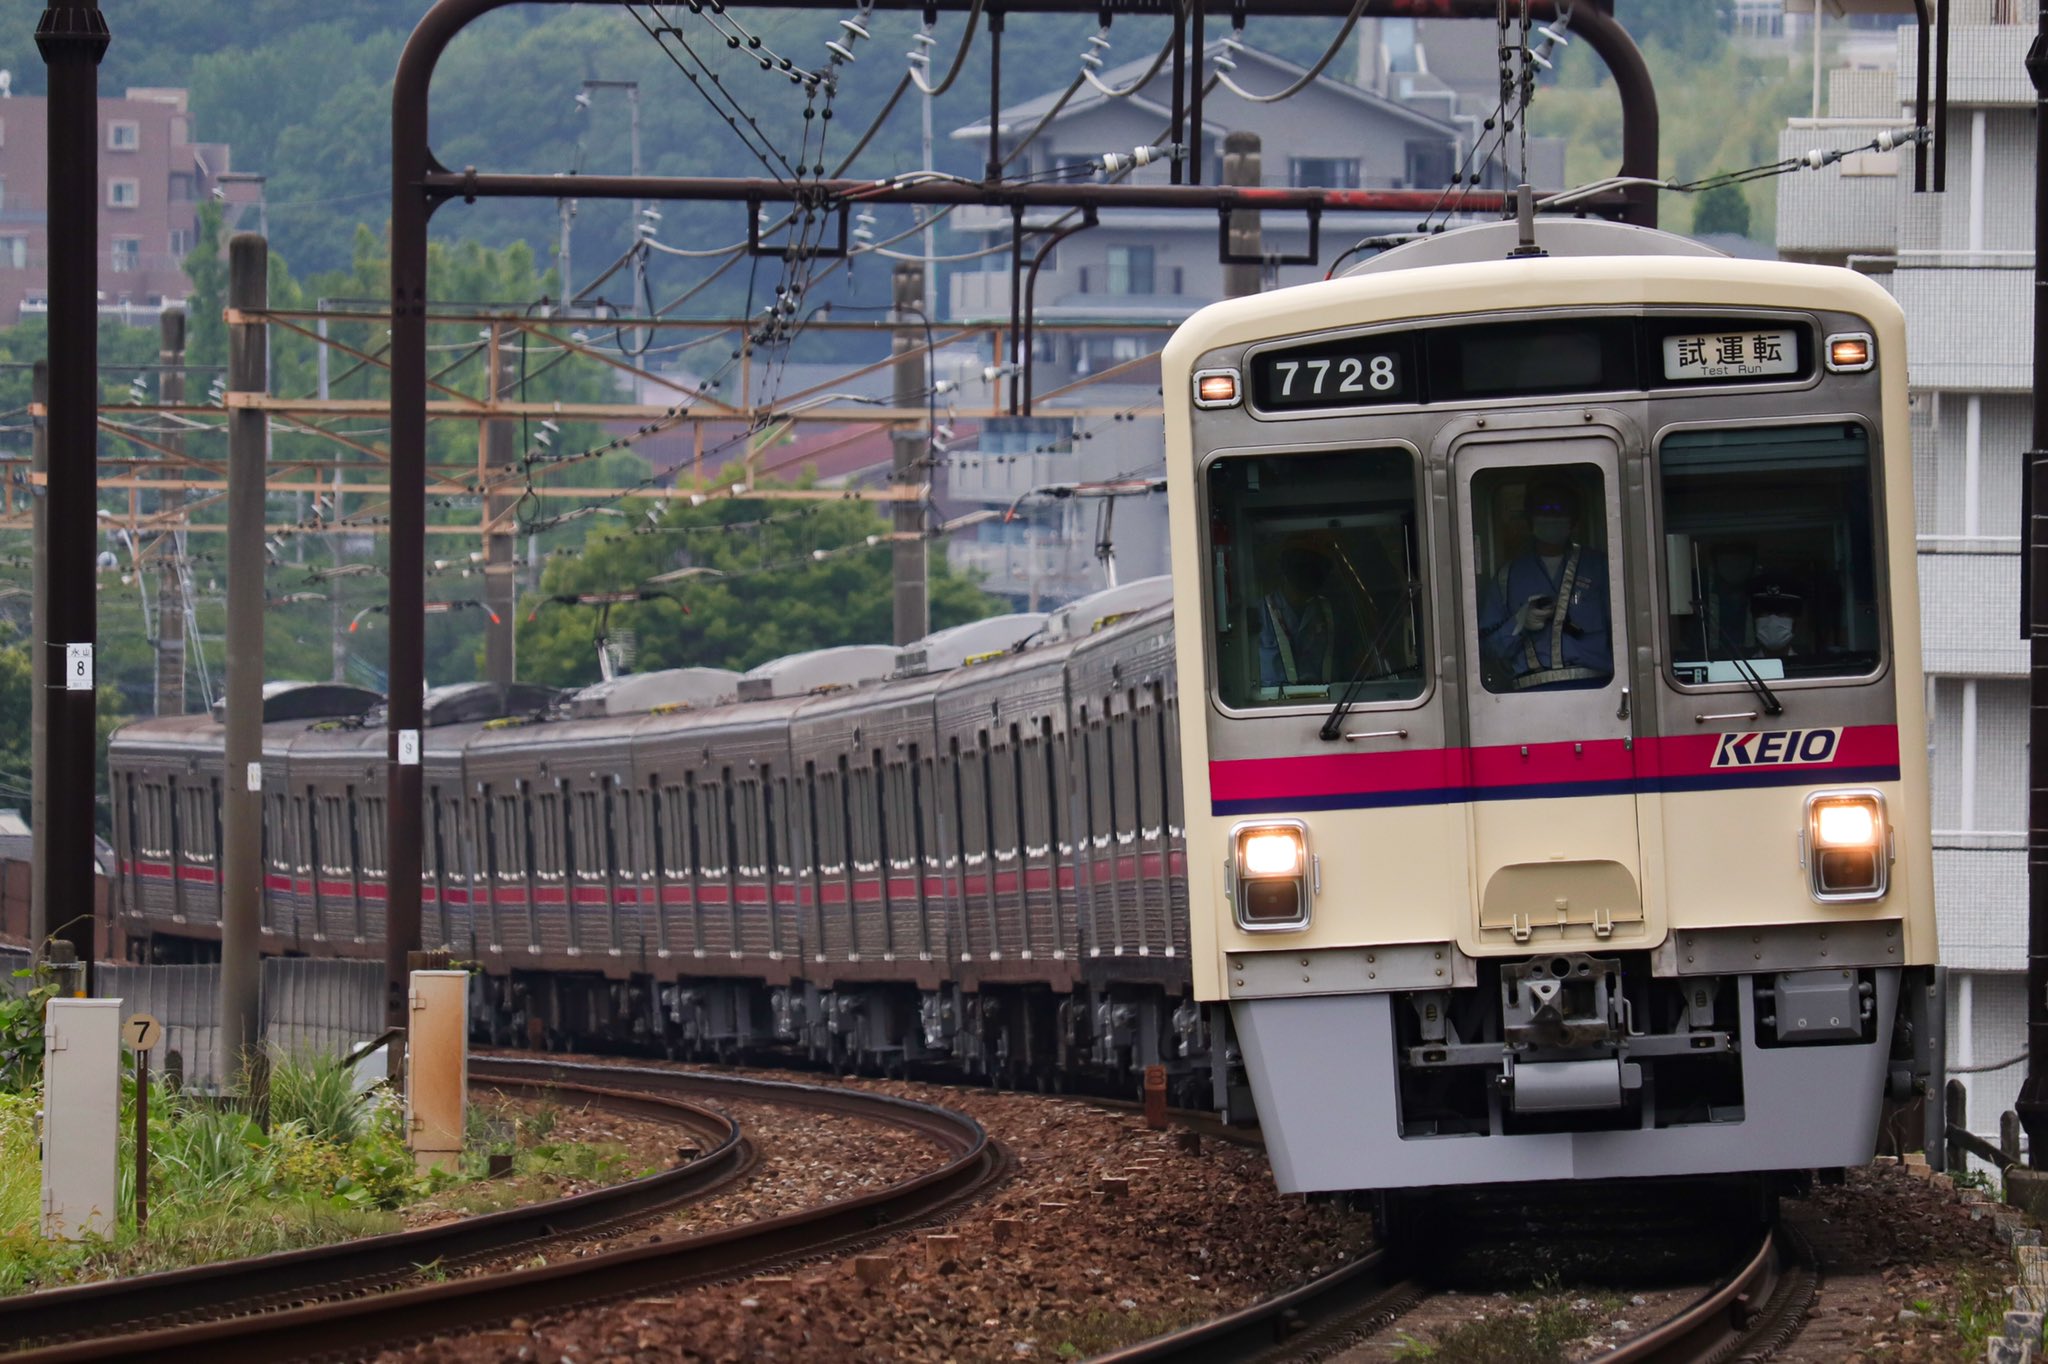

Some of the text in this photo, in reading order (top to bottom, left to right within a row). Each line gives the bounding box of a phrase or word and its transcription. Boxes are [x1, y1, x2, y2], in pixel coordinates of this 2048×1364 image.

[1678, 334, 1782, 367] 試運転
[1276, 356, 1395, 396] 7728
[1701, 364, 1762, 376] Test Run
[77, 661, 85, 676] 8
[405, 742, 412, 754] 9
[1717, 729, 1836, 765] KEIO
[133, 1021, 150, 1043] 7
